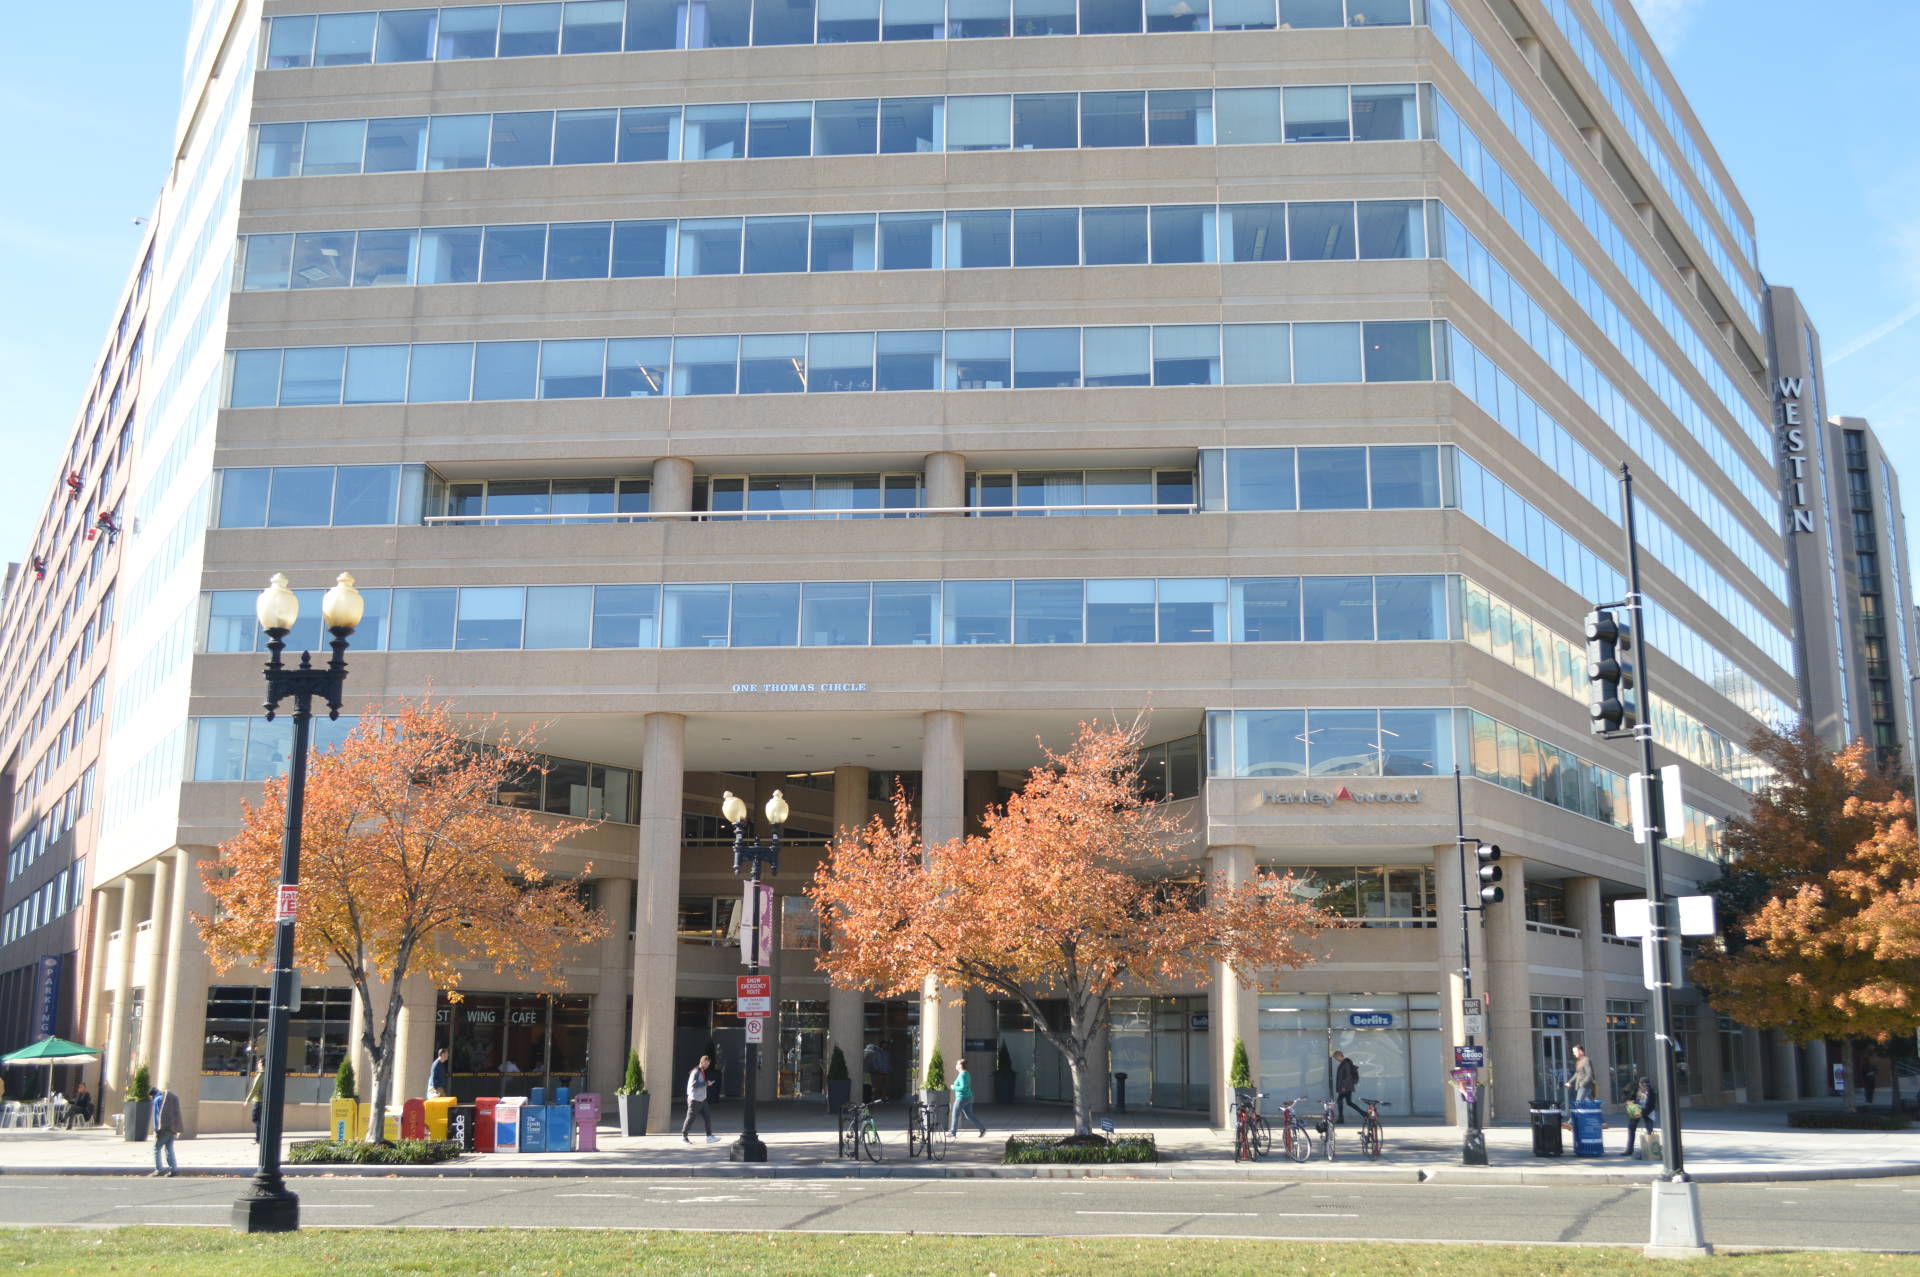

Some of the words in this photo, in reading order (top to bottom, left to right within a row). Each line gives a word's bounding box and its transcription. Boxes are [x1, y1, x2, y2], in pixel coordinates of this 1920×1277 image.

[1778, 376, 1815, 534] WESTIN
[732, 684, 758, 692] ONE
[763, 683, 815, 692] THOMAS
[820, 683, 867, 691] CIRCLE
[41, 968, 54, 1031] PARKING
[466, 1010, 496, 1023] WING
[1353, 1014, 1389, 1025] Berlitz
